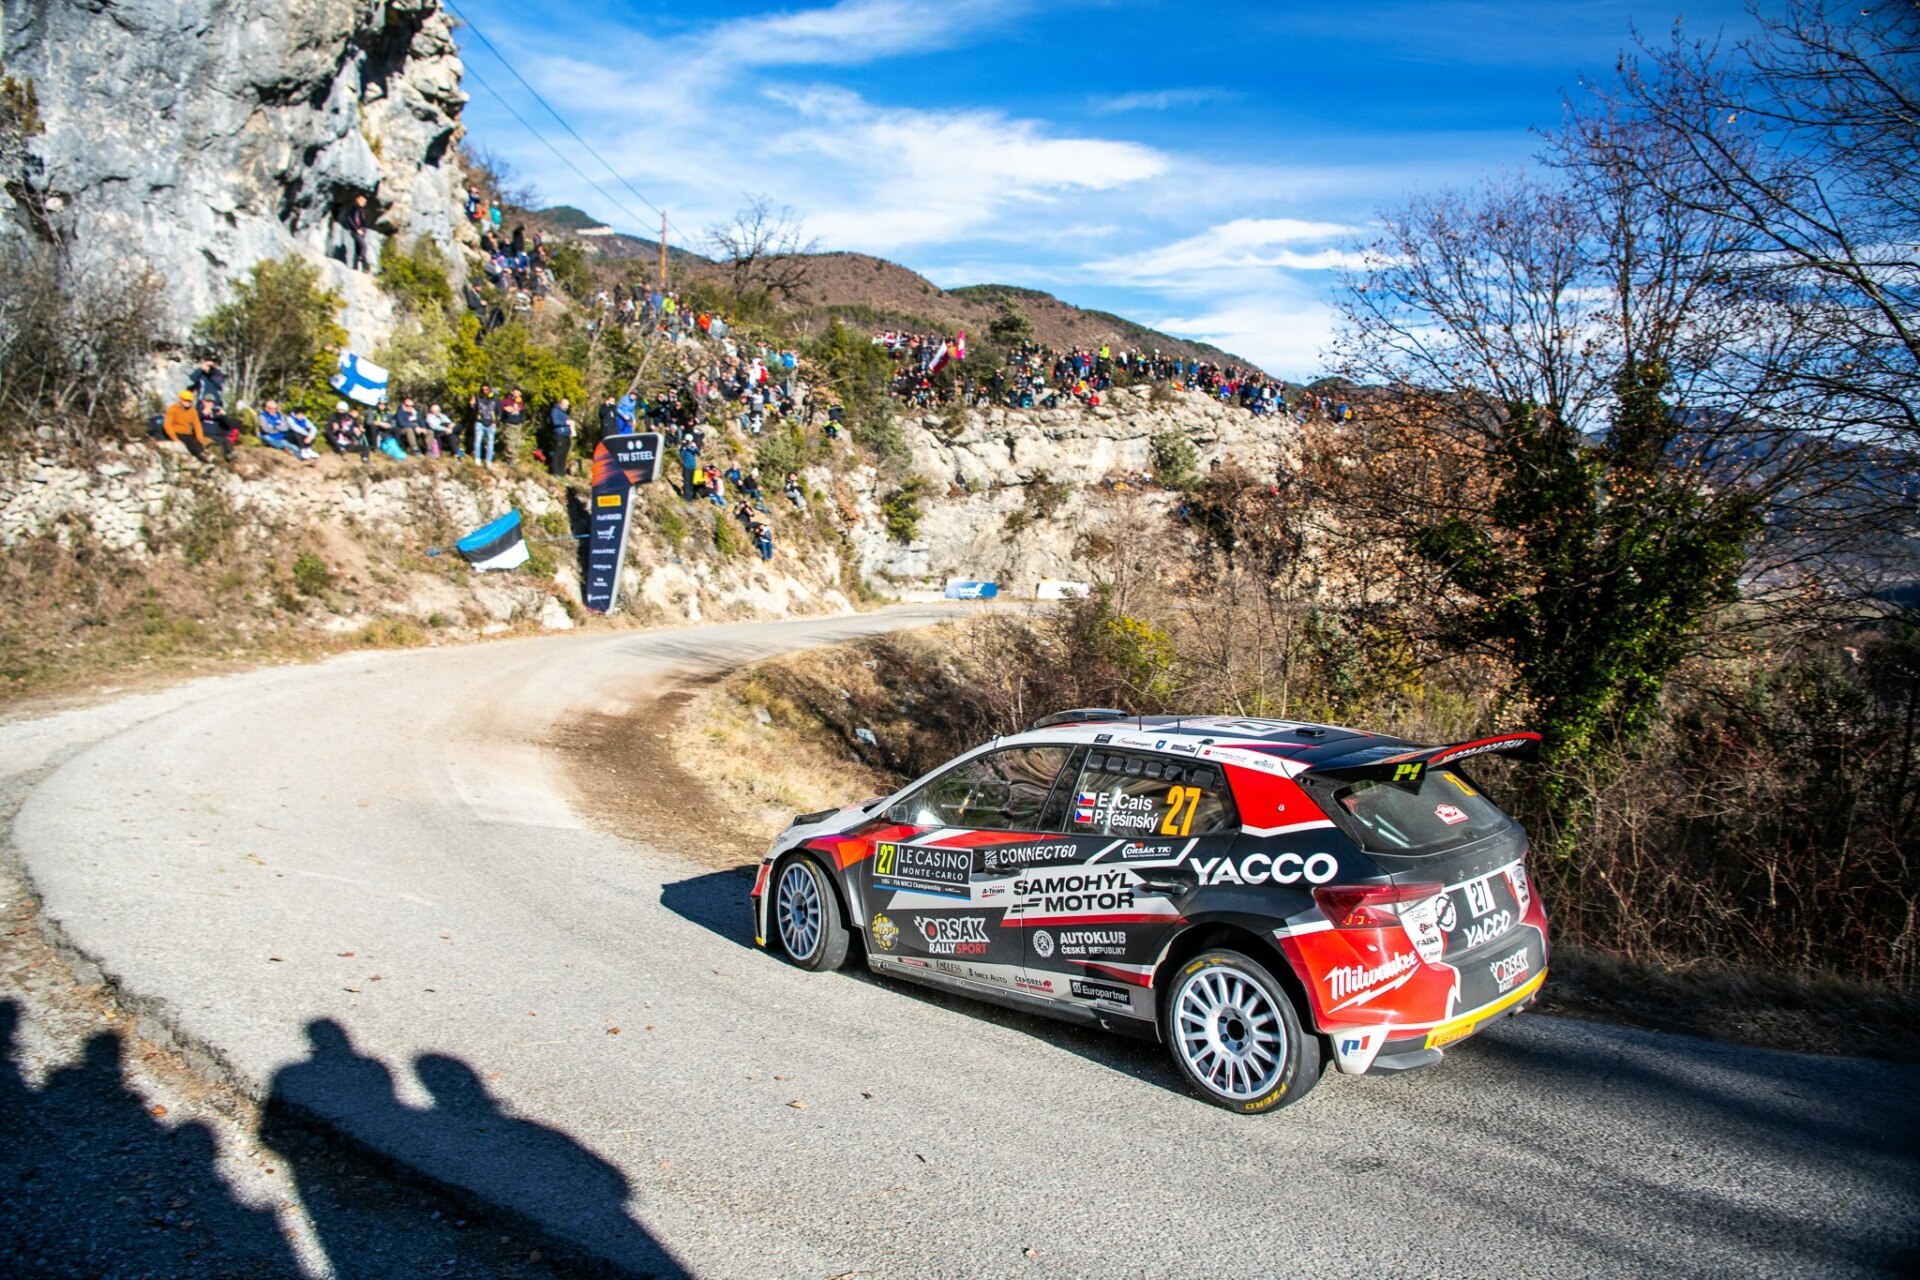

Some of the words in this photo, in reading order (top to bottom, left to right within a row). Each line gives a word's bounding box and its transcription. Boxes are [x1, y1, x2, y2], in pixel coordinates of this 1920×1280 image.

[617, 452, 630, 462] TW
[630, 451, 655, 462] STEEL
[1118, 793, 1153, 811] Cais
[1160, 785, 1202, 836] 27
[878, 844, 894, 874] 27
[900, 848, 913, 864] LE
[915, 851, 969, 870] CASINO
[1000, 844, 1077, 865] CONNECT60
[1189, 852, 1339, 886] YACCO
[913, 881, 941, 892] Championship
[1013, 869, 1134, 896] SAMOHÝL
[1045, 892, 1135, 913] MOTOR
[1059, 931, 1127, 944] AUTOKLUB
[1462, 909, 1511, 949] YACCO
[1061, 944, 1087, 955] ČESKÉ
[1088, 946, 1127, 955] REPUBLIKY
[936, 960, 962, 973] ENDLESS
[1322, 950, 1419, 1001] Milwaukee
[1082, 985, 1129, 1002] Europartner
